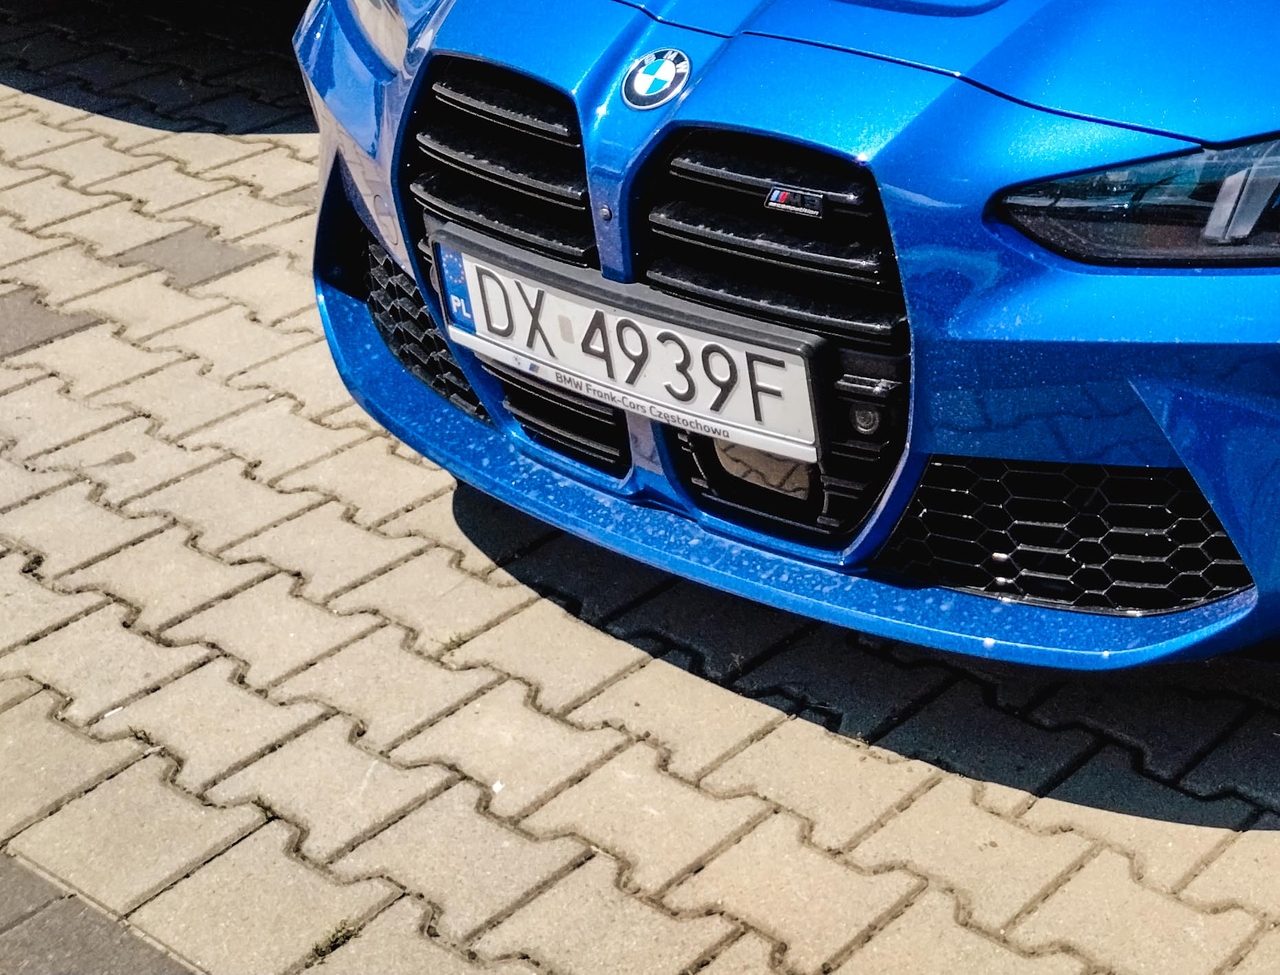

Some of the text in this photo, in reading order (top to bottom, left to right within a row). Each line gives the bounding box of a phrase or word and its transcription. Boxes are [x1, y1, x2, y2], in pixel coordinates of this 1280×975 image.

[450, 294, 471, 318] PL
[475, 265, 786, 422] DX 4939F
[555, 372, 730, 438] BMW Frank-Cars Częstochowa
